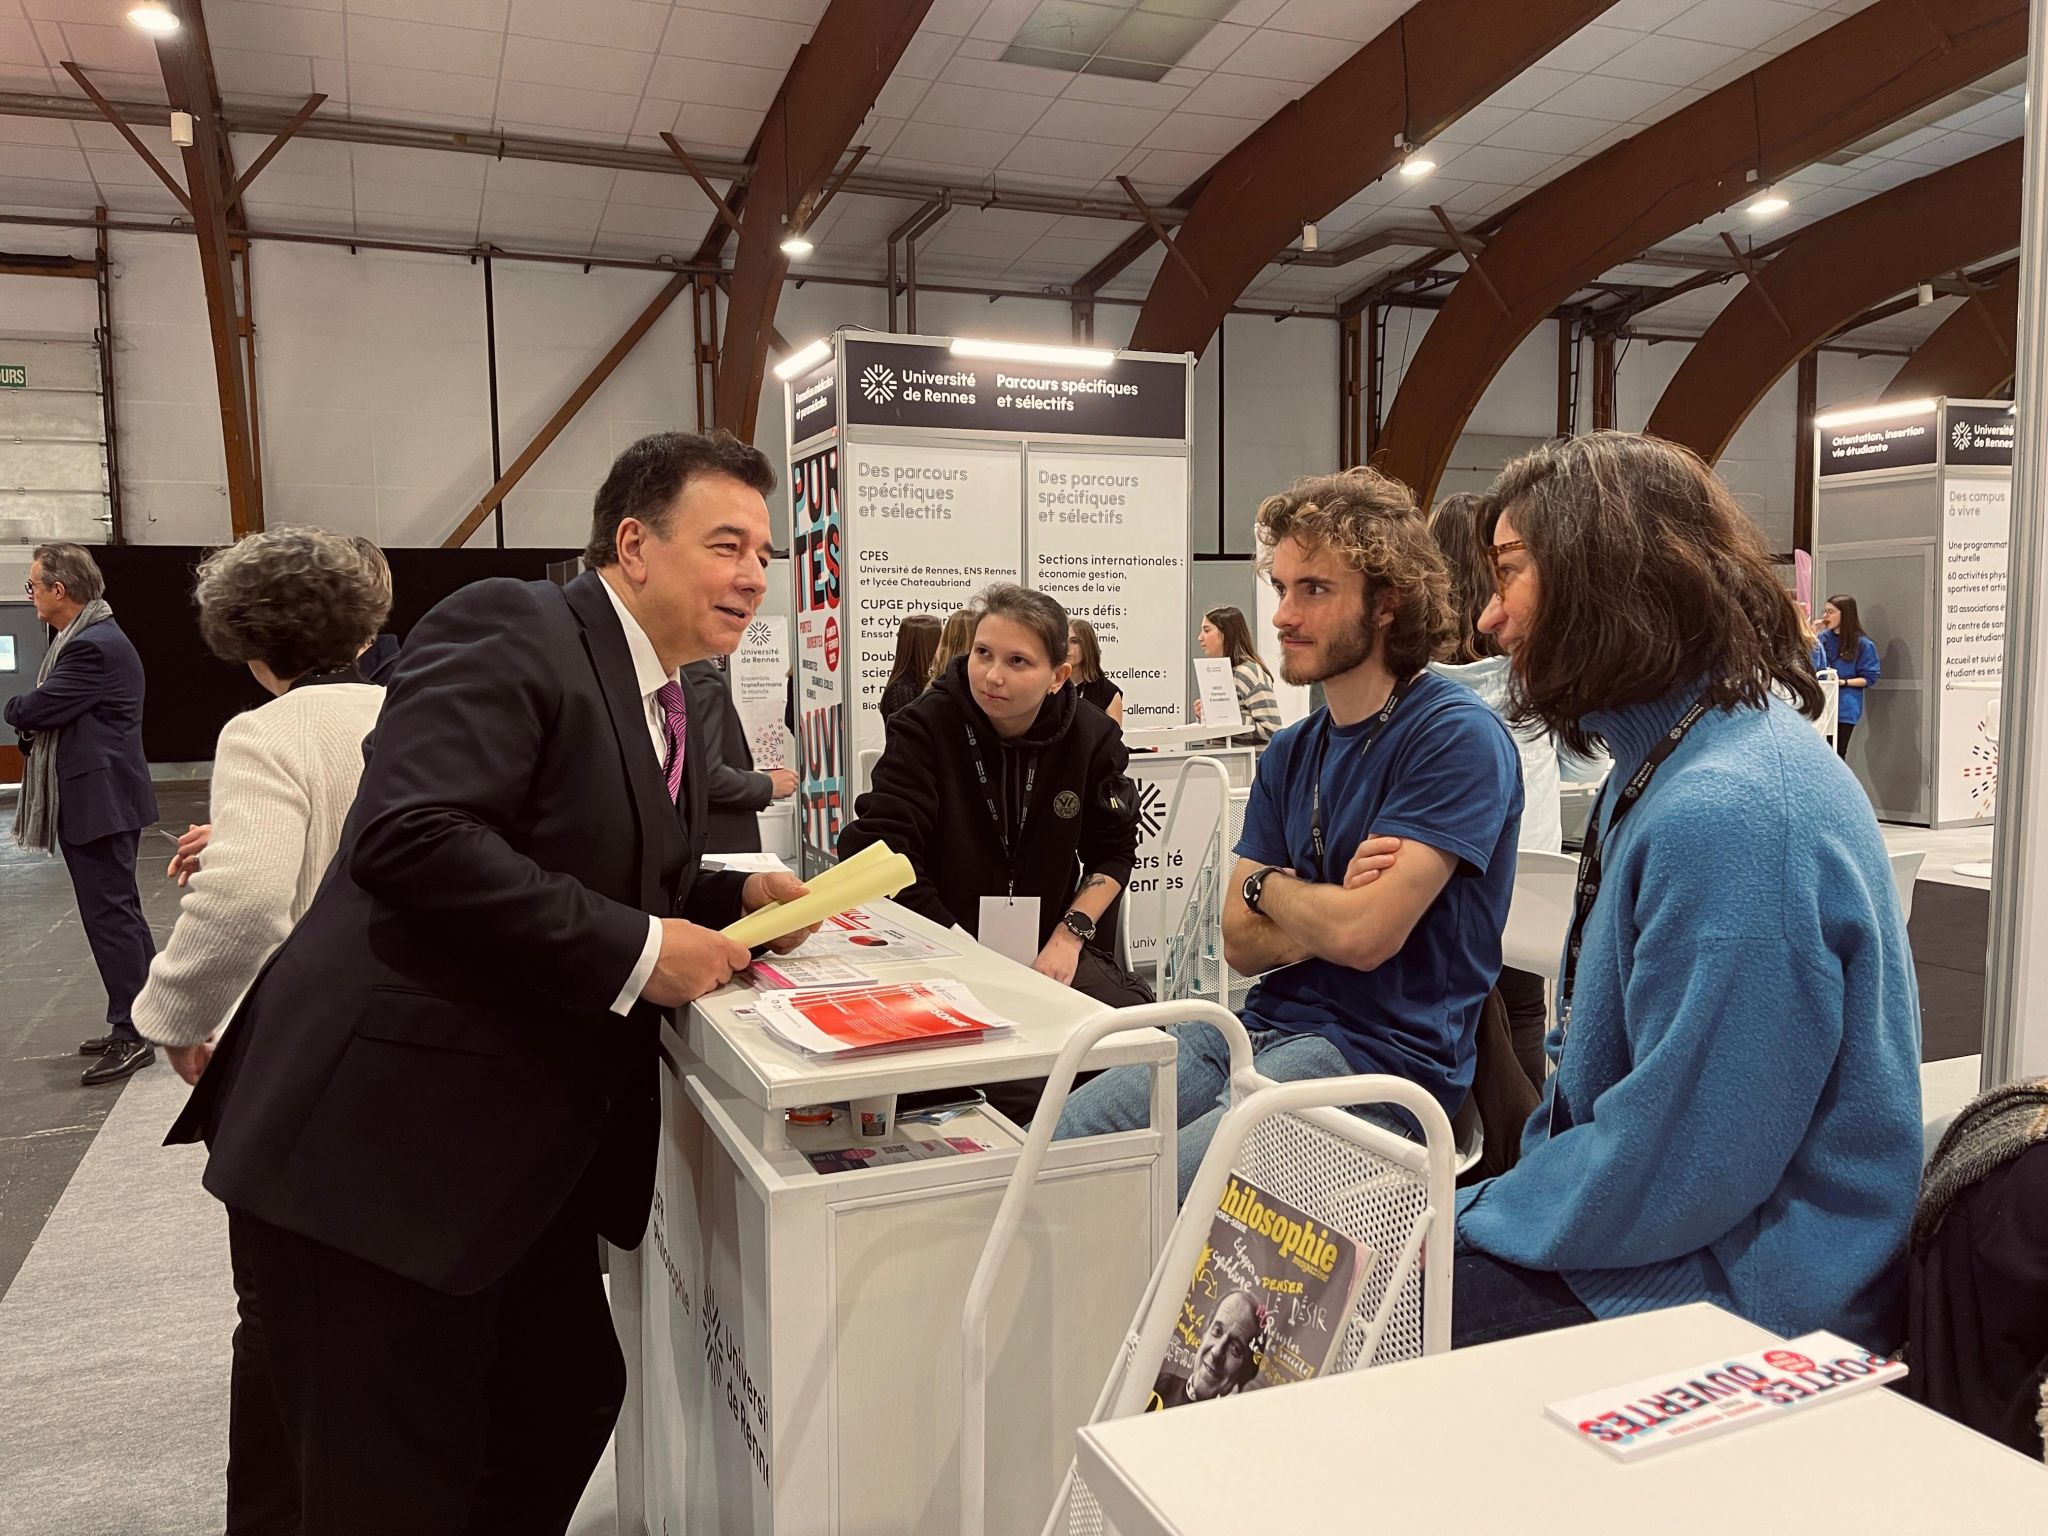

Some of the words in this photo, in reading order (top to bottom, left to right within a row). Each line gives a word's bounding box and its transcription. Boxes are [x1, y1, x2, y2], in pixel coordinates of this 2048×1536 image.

[0, 369, 24, 384] URS
[903, 370, 976, 387] Université
[997, 374, 1059, 391] Parcours
[1061, 378, 1139, 398] spécifiques
[903, 387, 921, 401] de
[924, 389, 976, 404] Rennes
[996, 395, 1013, 408] et
[1015, 395, 1075, 411] sélectifs
[1832, 432, 1884, 446] Orientation,
[1885, 426, 1925, 440] insertion
[1974, 424, 2014, 436] Université
[1974, 437, 1984, 448] de
[1985, 438, 2014, 449] Rennes
[1832, 447, 1845, 458] vie
[1846, 443, 1888, 456] étudiante
[859, 462, 890, 478] Des
[894, 466, 968, 483] parcours
[1039, 470, 1067, 484] Des
[1071, 474, 1139, 489] parcours
[858, 483, 954, 503] spécifiques
[1038, 489, 1126, 509] spécifiques
[1949, 491, 1967, 502] Des
[1969, 492, 2005, 505] campus
[859, 503, 877, 517] et
[881, 502, 952, 520] sélectifs
[1039, 509, 1055, 523] et
[1058, 508, 1124, 524] sélectifs
[1949, 505, 1956, 517] à
[1957, 505, 1981, 517] vivre
[1948, 541, 1962, 549] Une
[1963, 541, 2008, 551] programmat
[859, 551, 889, 561] CPES
[1038, 554, 1088, 565] Sections
[1091, 555, 1177, 566] internationales
[1948, 553, 1980, 562] culturelle
[860, 565, 909, 574] Université
[911, 565, 923, 574] de
[925, 567, 962, 576] Rennes,
[964, 567, 982, 575] ENS
[1038, 569, 1086, 579] économie
[1088, 570, 1127, 581] gestion,
[1948, 572, 1957, 580] 60
[1958, 571, 1988, 580] activités
[1989, 571, 2006, 581] phys
[860, 578, 870, 586] et
[873, 578, 898, 588] lycée
[900, 578, 971, 587] Chateaubriand
[1038, 583, 1079, 592] sciences
[1082, 582, 1094, 592] de
[1096, 582, 1105, 592] la
[1107, 583, 1121, 592] vie
[1947, 584, 1980, 594] sportives
[861, 600, 903, 610] CUPGE
[907, 599, 963, 613] physique
[1064, 607, 1090, 616] ours
[1093, 605, 1121, 616] défis
[1959, 604, 1999, 613] associations
[861, 616, 874, 626] et
[1091, 621, 1119, 630] iques,
[1947, 622, 1956, 630] Un
[1958, 621, 1980, 630] centre
[1982, 620, 1990, 628] de
[1097, 633, 1119, 643] imie,
[1947, 635, 1963, 645] pour
[1965, 634, 1974, 642] les
[1975, 633, 2004, 641] étudiant
[862, 652, 895, 662] Doub
[1946, 655, 1970, 665] Accueil
[1981, 653, 1996, 663] suivi
[1104, 668, 1160, 679] excellence
[862, 685, 875, 694] et
[1123, 703, 1175, 715] -allemand
[653, 1219, 690, 1316] philosophie
[1292, 1255, 1330, 1283] magazine
[1261, 1275, 1304, 1294] PENSER
[726, 1324, 769, 1434] Universi
[1753, 1347, 1897, 1405] PORTES
[1578, 1362, 1769, 1443] OUVERTES
[727, 1375, 739, 1422] de
[740, 1401, 769, 1490] Renn
